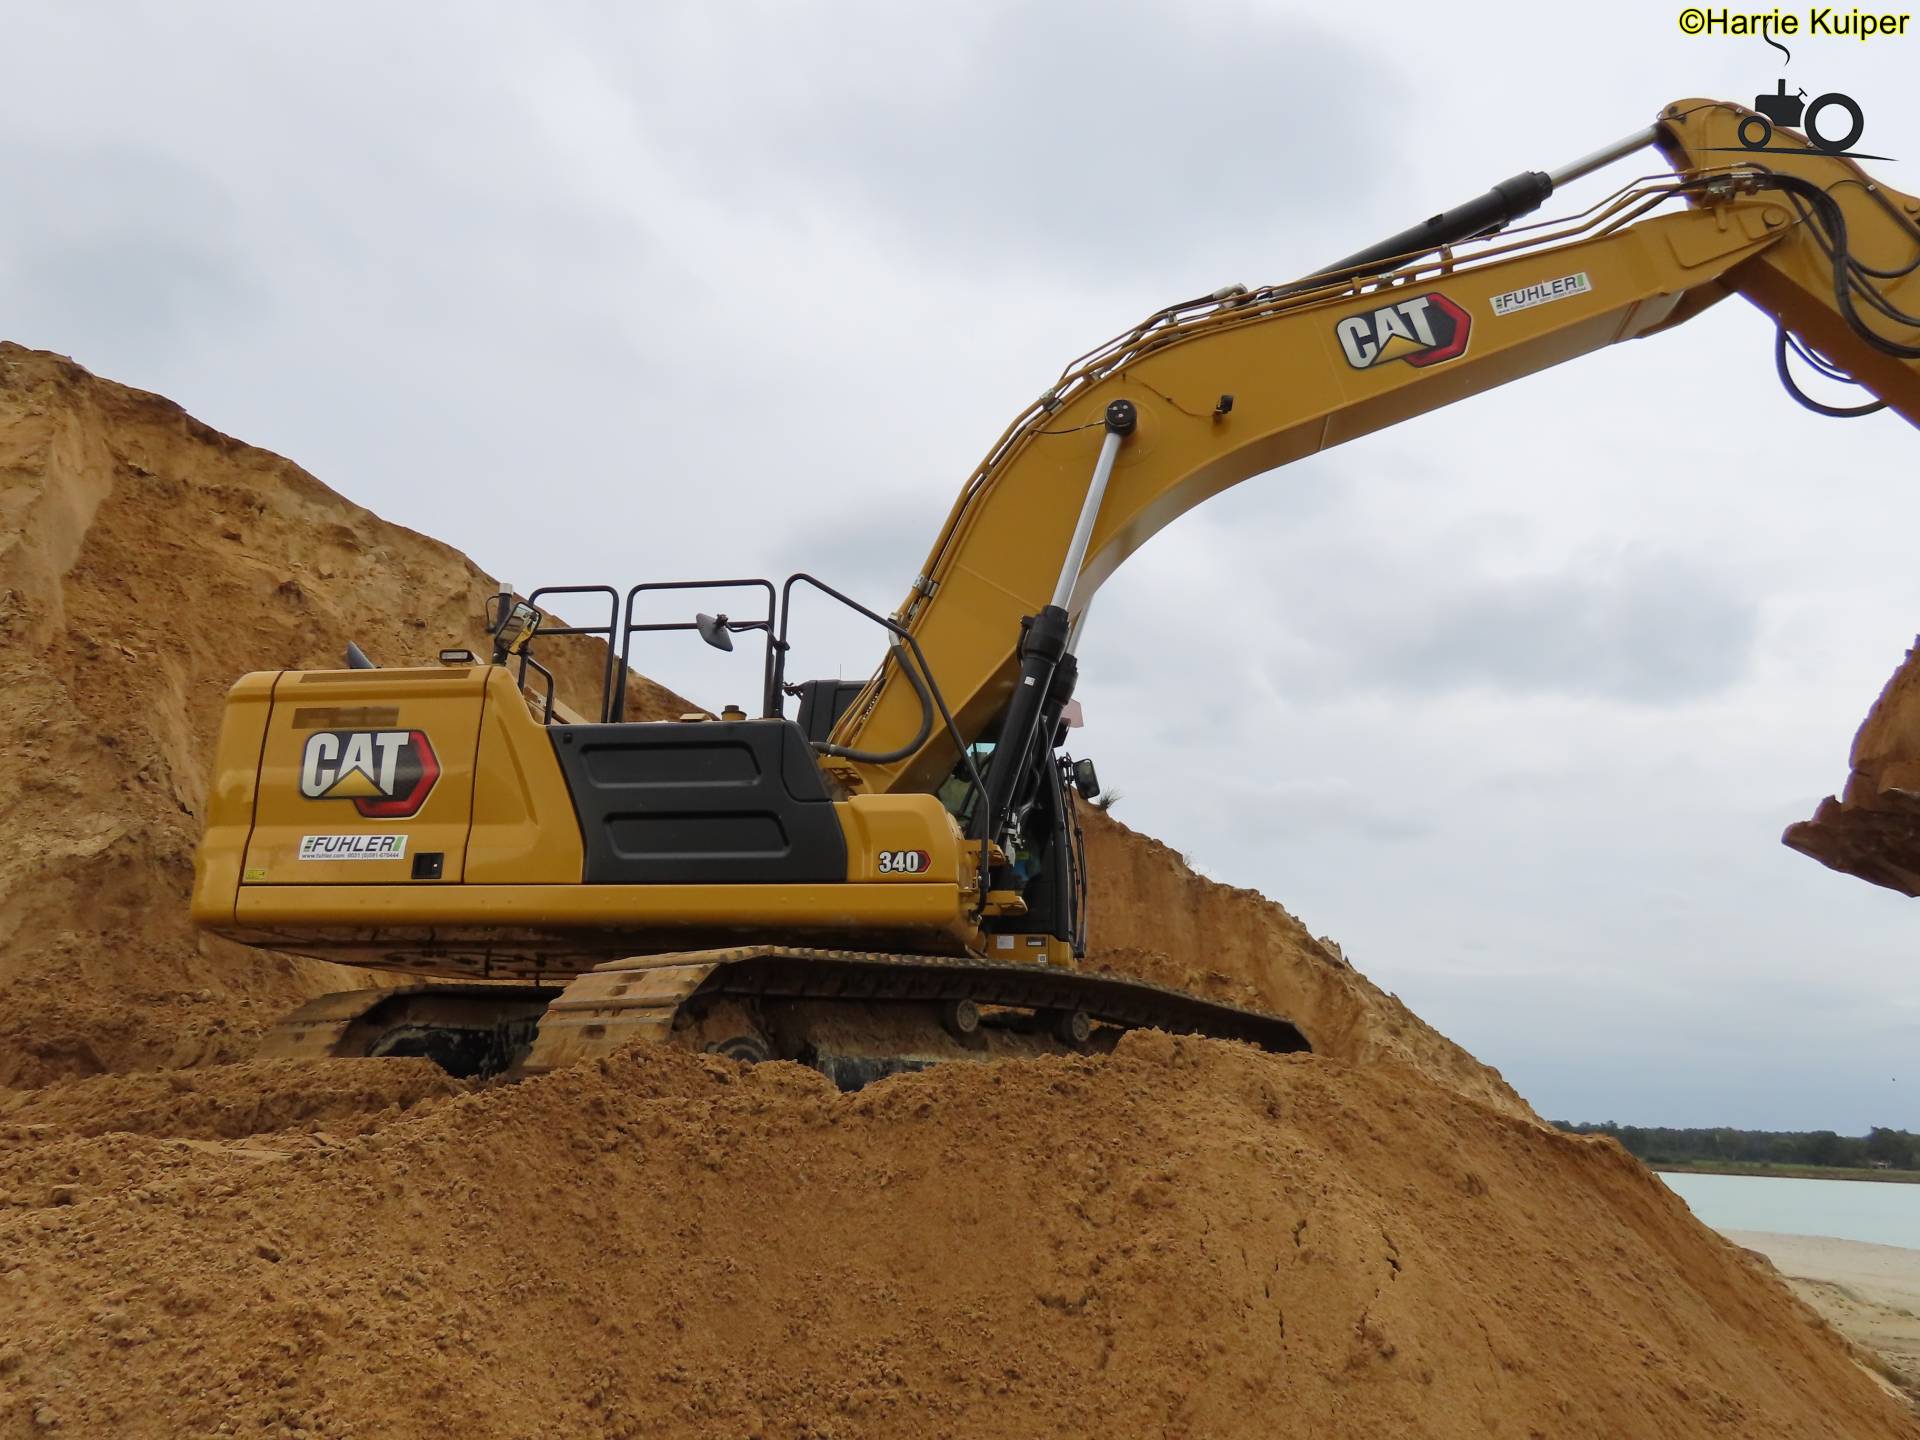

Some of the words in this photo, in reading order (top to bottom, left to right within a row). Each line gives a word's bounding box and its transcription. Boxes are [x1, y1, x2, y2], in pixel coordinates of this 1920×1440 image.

[1503, 276, 1579, 308] FUHLER
[1337, 296, 1436, 368] CAT
[302, 732, 410, 797] CAT
[312, 836, 395, 852] FUHLER
[879, 852, 919, 872] 340
